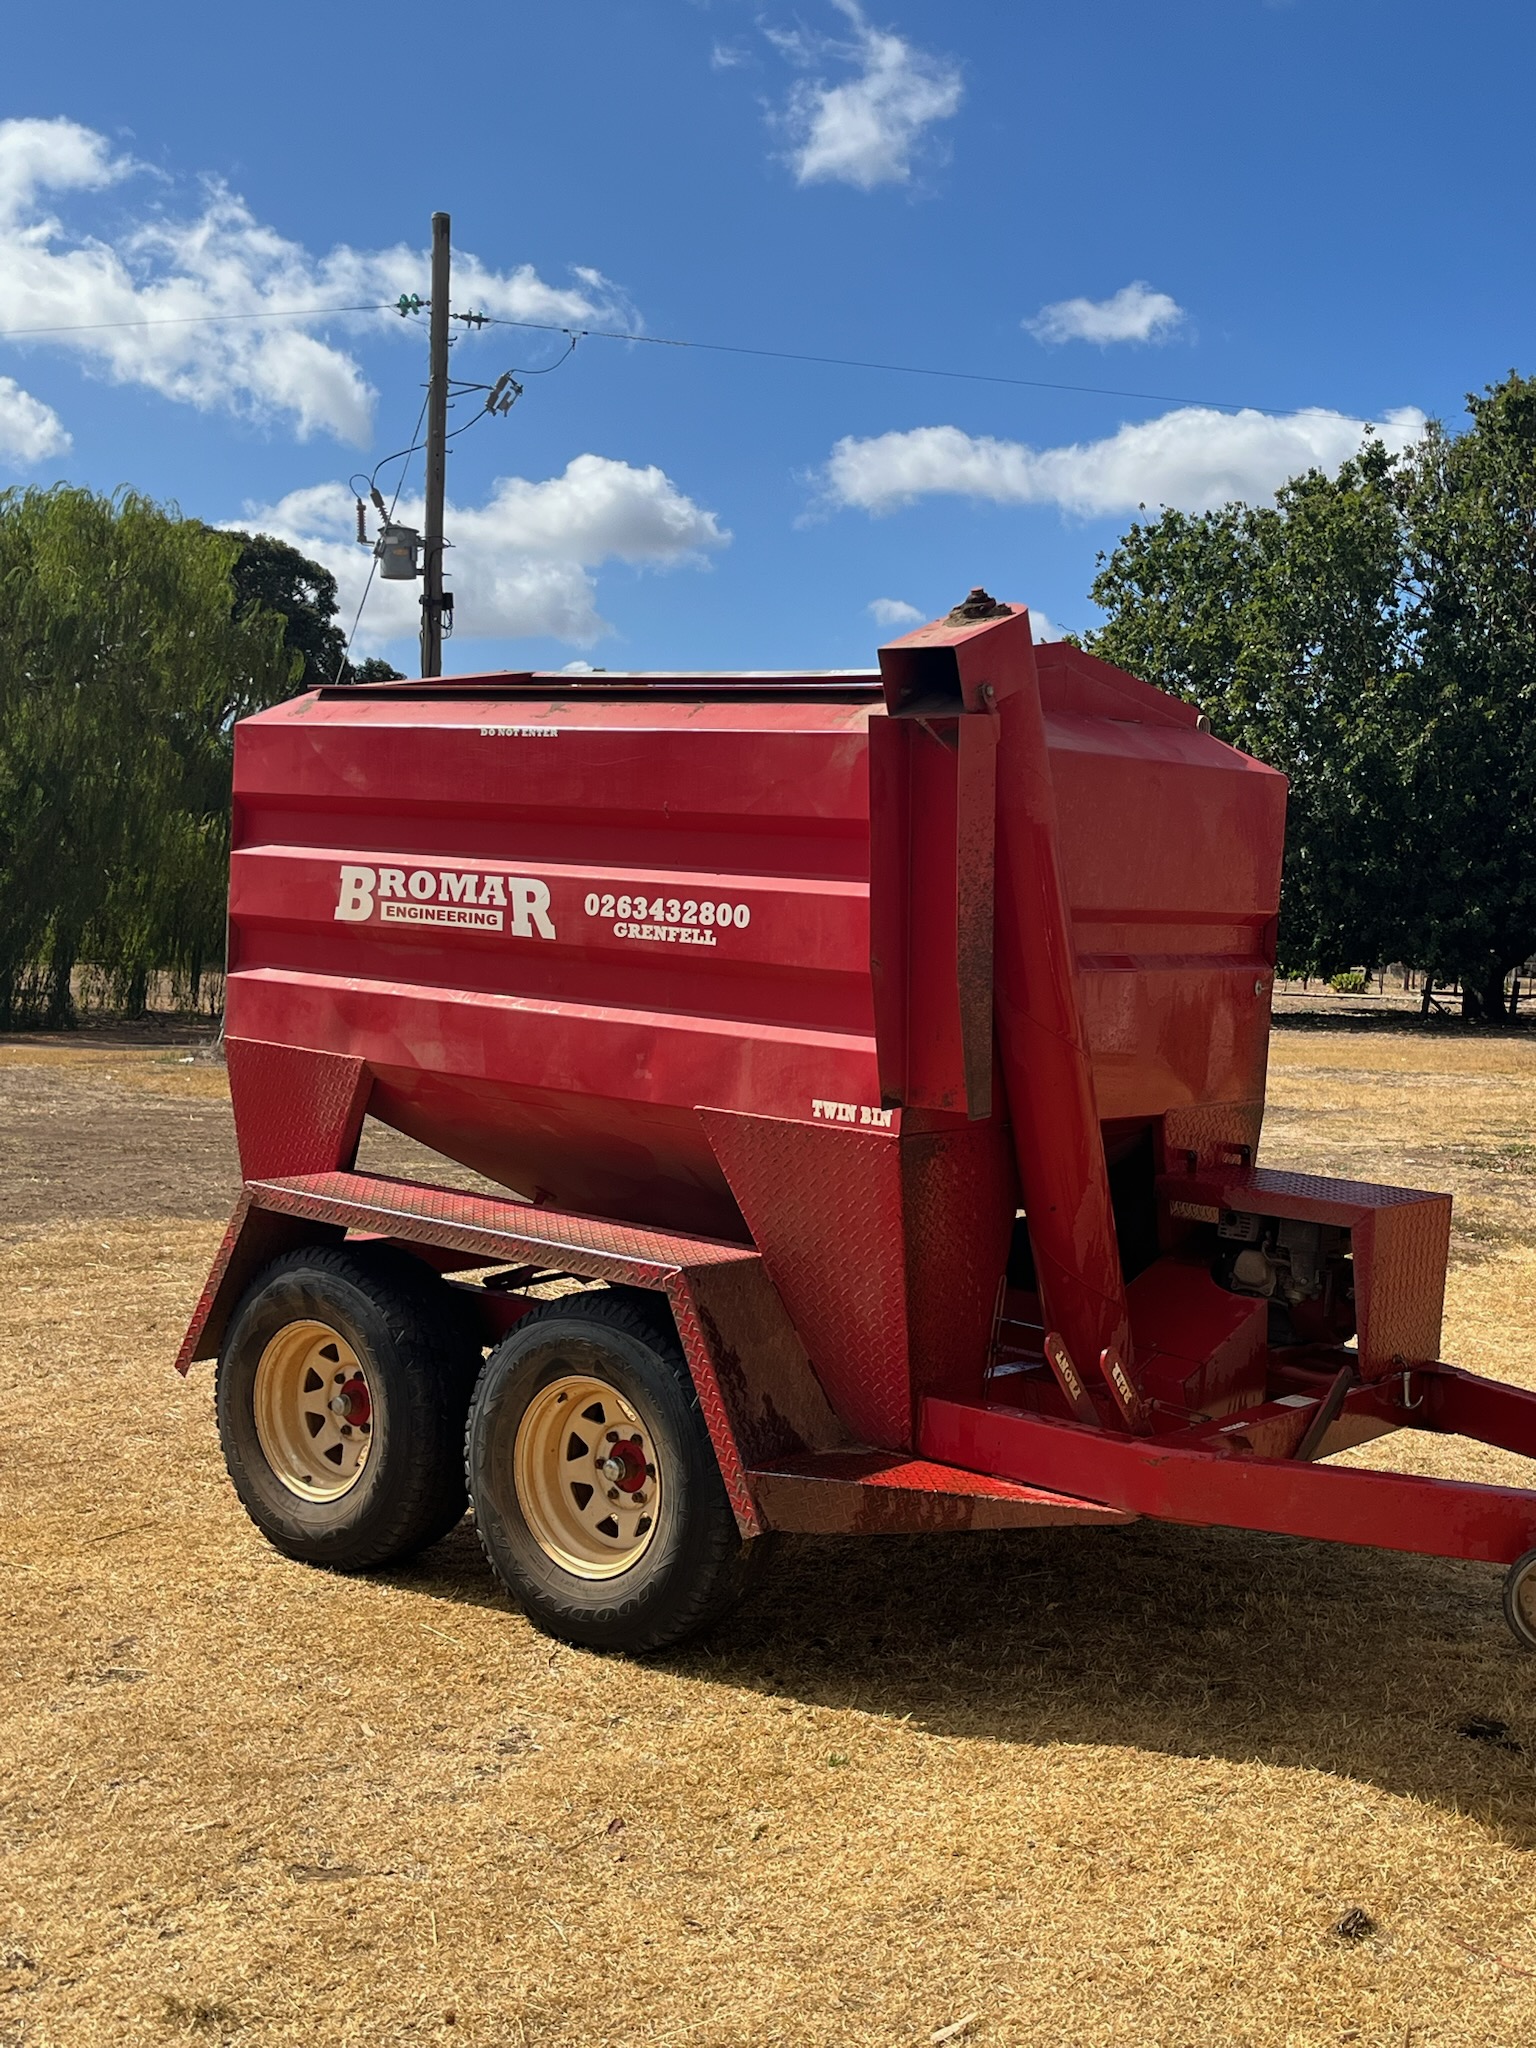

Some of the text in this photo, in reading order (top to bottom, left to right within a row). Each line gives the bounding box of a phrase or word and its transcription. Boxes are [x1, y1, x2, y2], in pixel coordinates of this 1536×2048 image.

[480, 727, 559, 738] DO NOT ENTER
[334, 865, 556, 940] BROMAR
[386, 905, 498, 926] ENGINEERING
[584, 893, 750, 929] 0263432800
[613, 922, 717, 946] GRENFELL
[812, 1099, 893, 1128] TWIN BIN
[1055, 1350, 1081, 1401] FRONT
[1112, 1362, 1133, 1405] REAR
